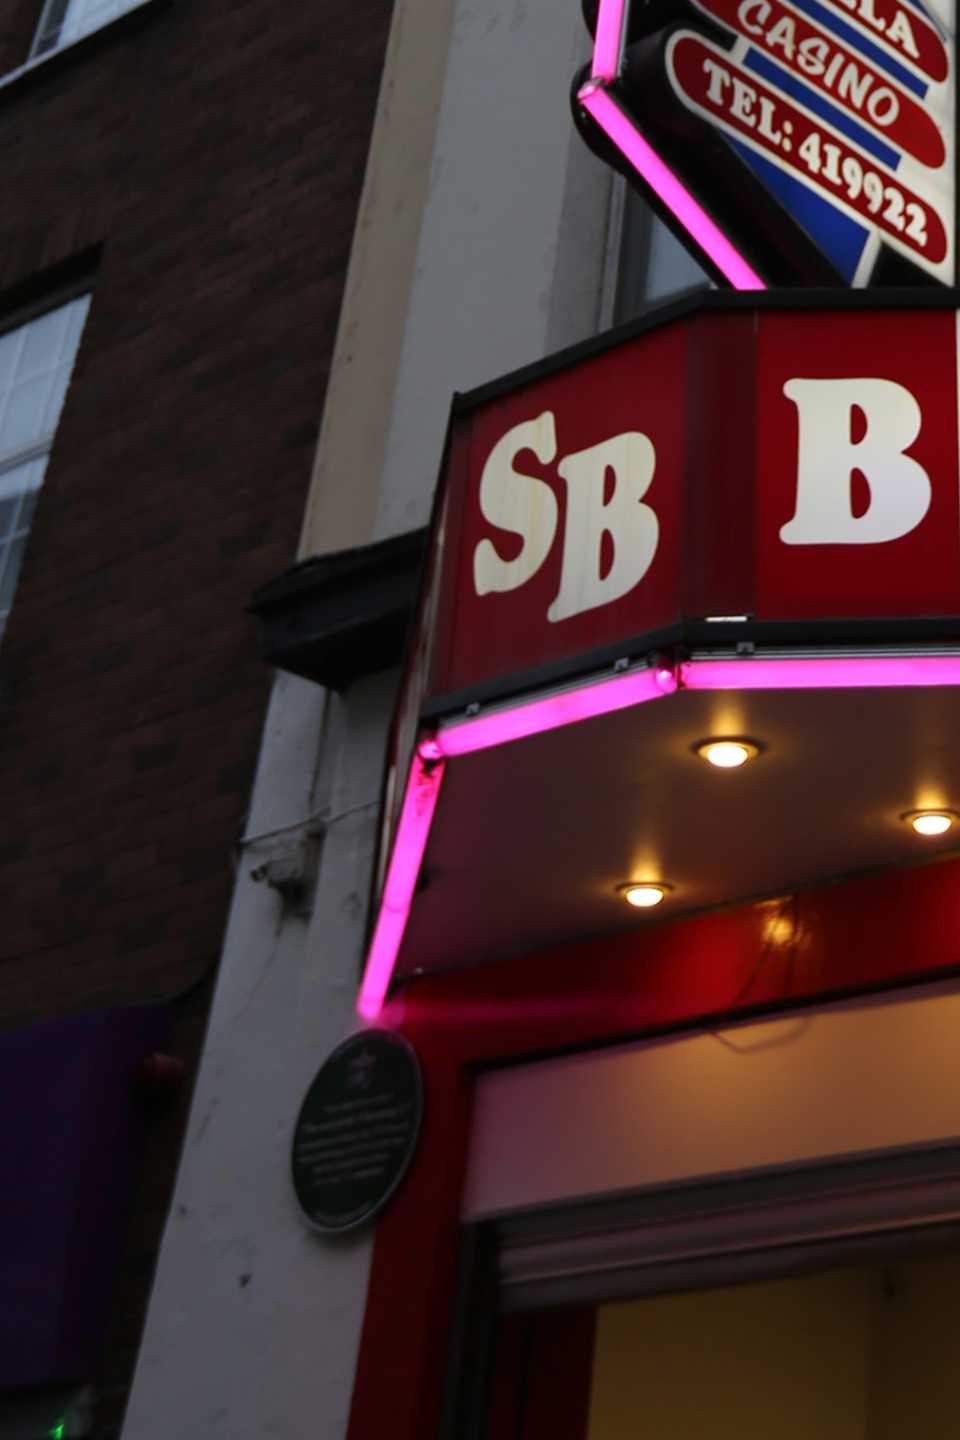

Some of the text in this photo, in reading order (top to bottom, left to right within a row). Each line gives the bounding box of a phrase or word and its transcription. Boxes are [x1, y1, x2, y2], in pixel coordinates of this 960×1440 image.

[702, 59, 928, 247] TEL: 419922
[474, 410, 660, 623] SB
